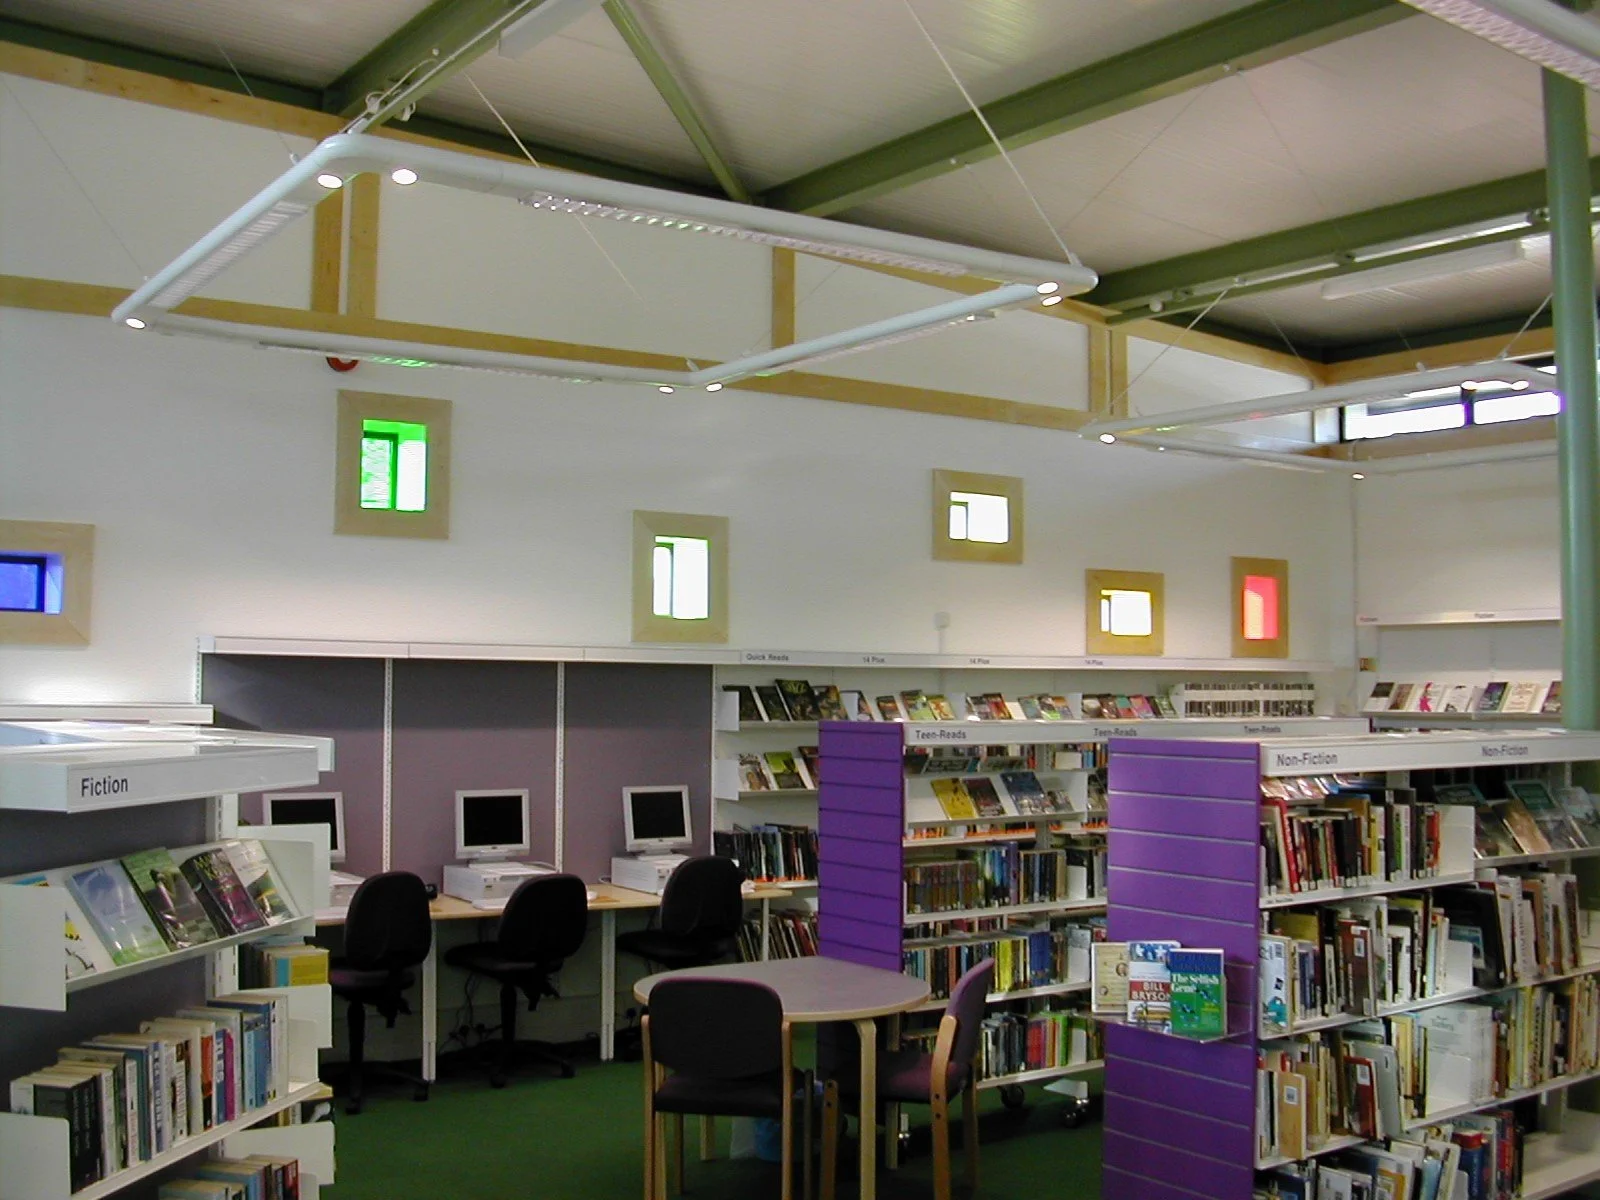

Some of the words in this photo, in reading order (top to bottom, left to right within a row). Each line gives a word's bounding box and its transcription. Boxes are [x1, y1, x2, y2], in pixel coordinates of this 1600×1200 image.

[746, 653, 766, 662] Quick
[768, 654, 789, 662] Reads
[863, 656, 871, 664] 14
[916, 729, 967, 740] Teen-Reads
[1093, 727, 1138, 738] Teen-Reads
[1243, 725, 1282, 734] Teen-Reads
[1481, 744, 1529, 757] Non-Fiction
[1277, 751, 1338, 767] Non-Fiction
[81, 775, 129, 798] Fiction
[1143, 981, 1164, 991] BILL
